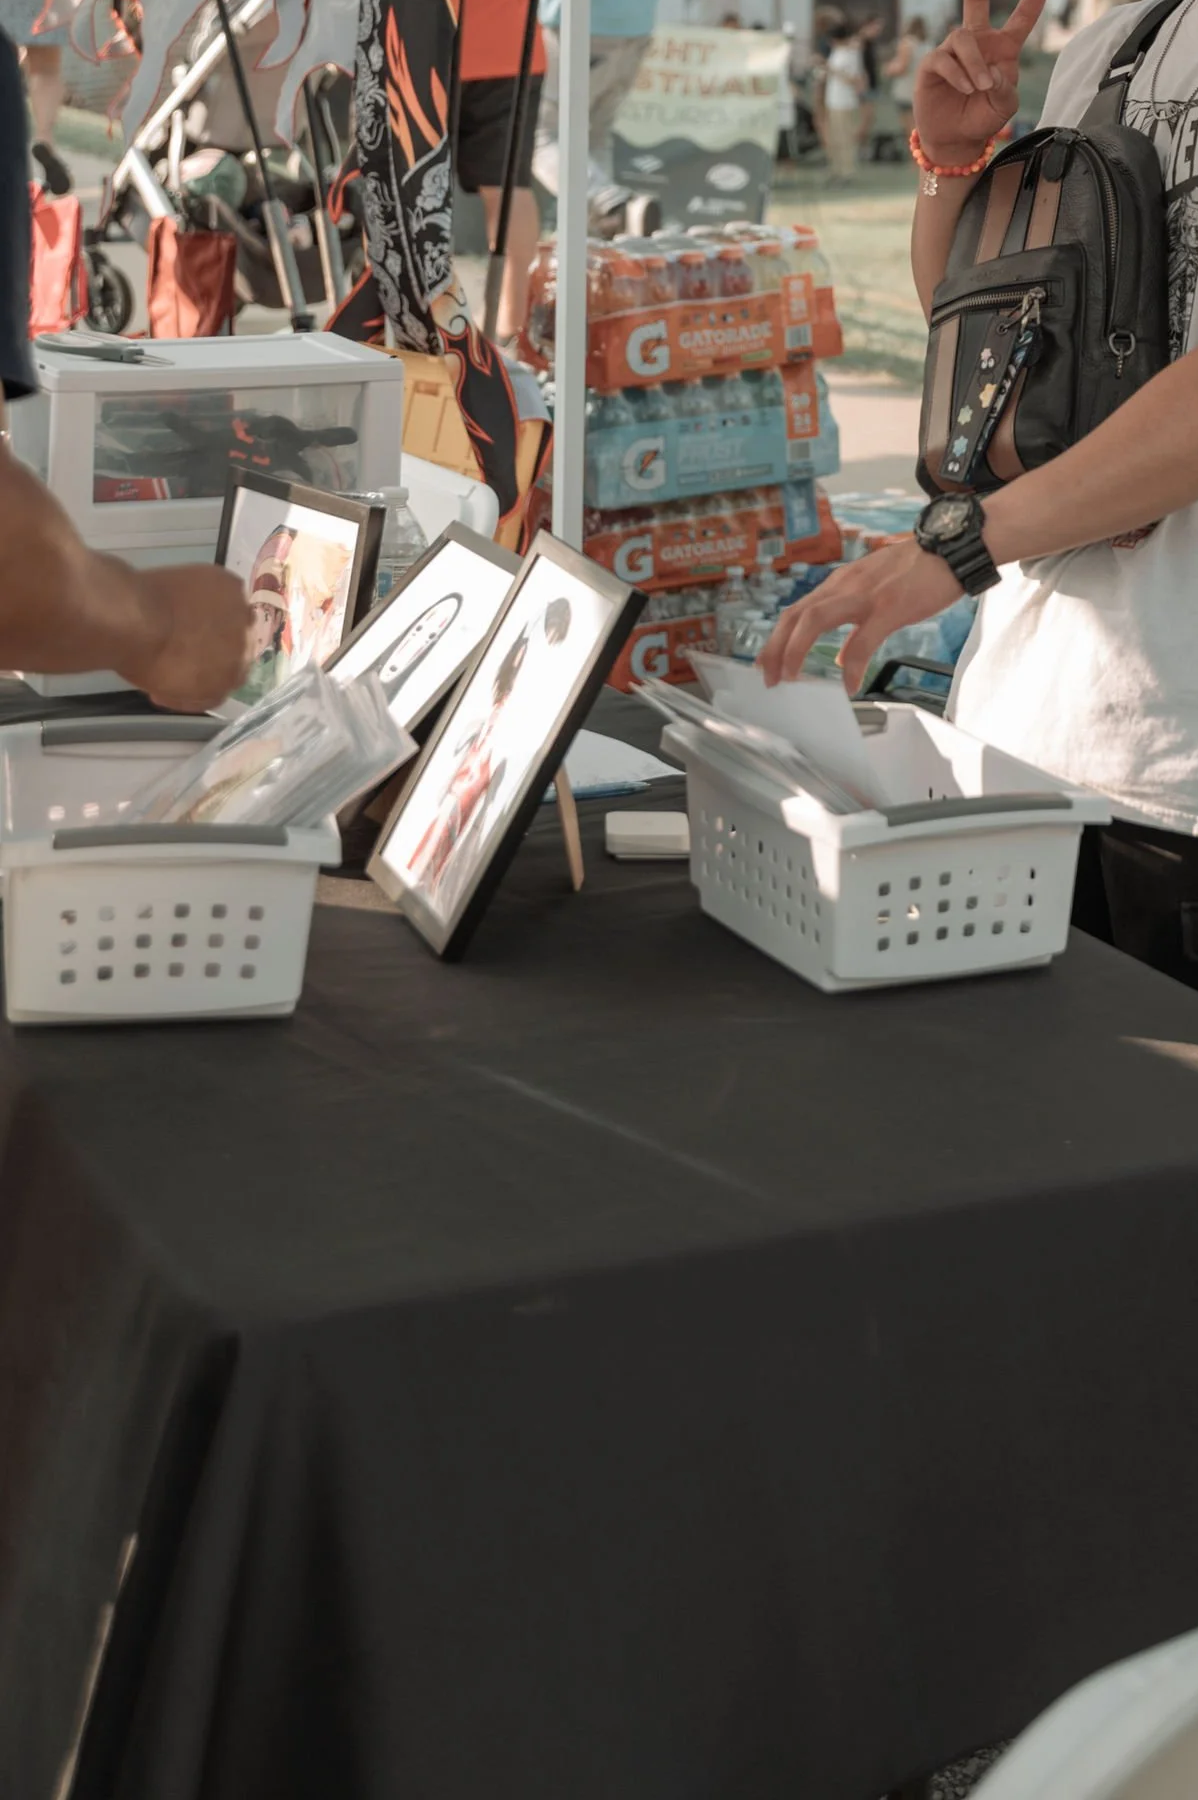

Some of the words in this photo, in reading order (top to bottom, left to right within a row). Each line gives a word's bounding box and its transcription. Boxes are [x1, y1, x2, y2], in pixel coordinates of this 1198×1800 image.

[625, 318, 670, 377] G
[678, 321, 774, 348] GATORADE
[622, 436, 667, 491] G
[613, 533, 654, 584] G
[659, 535, 748, 561] GATORADE
[630, 631, 670, 681] G
